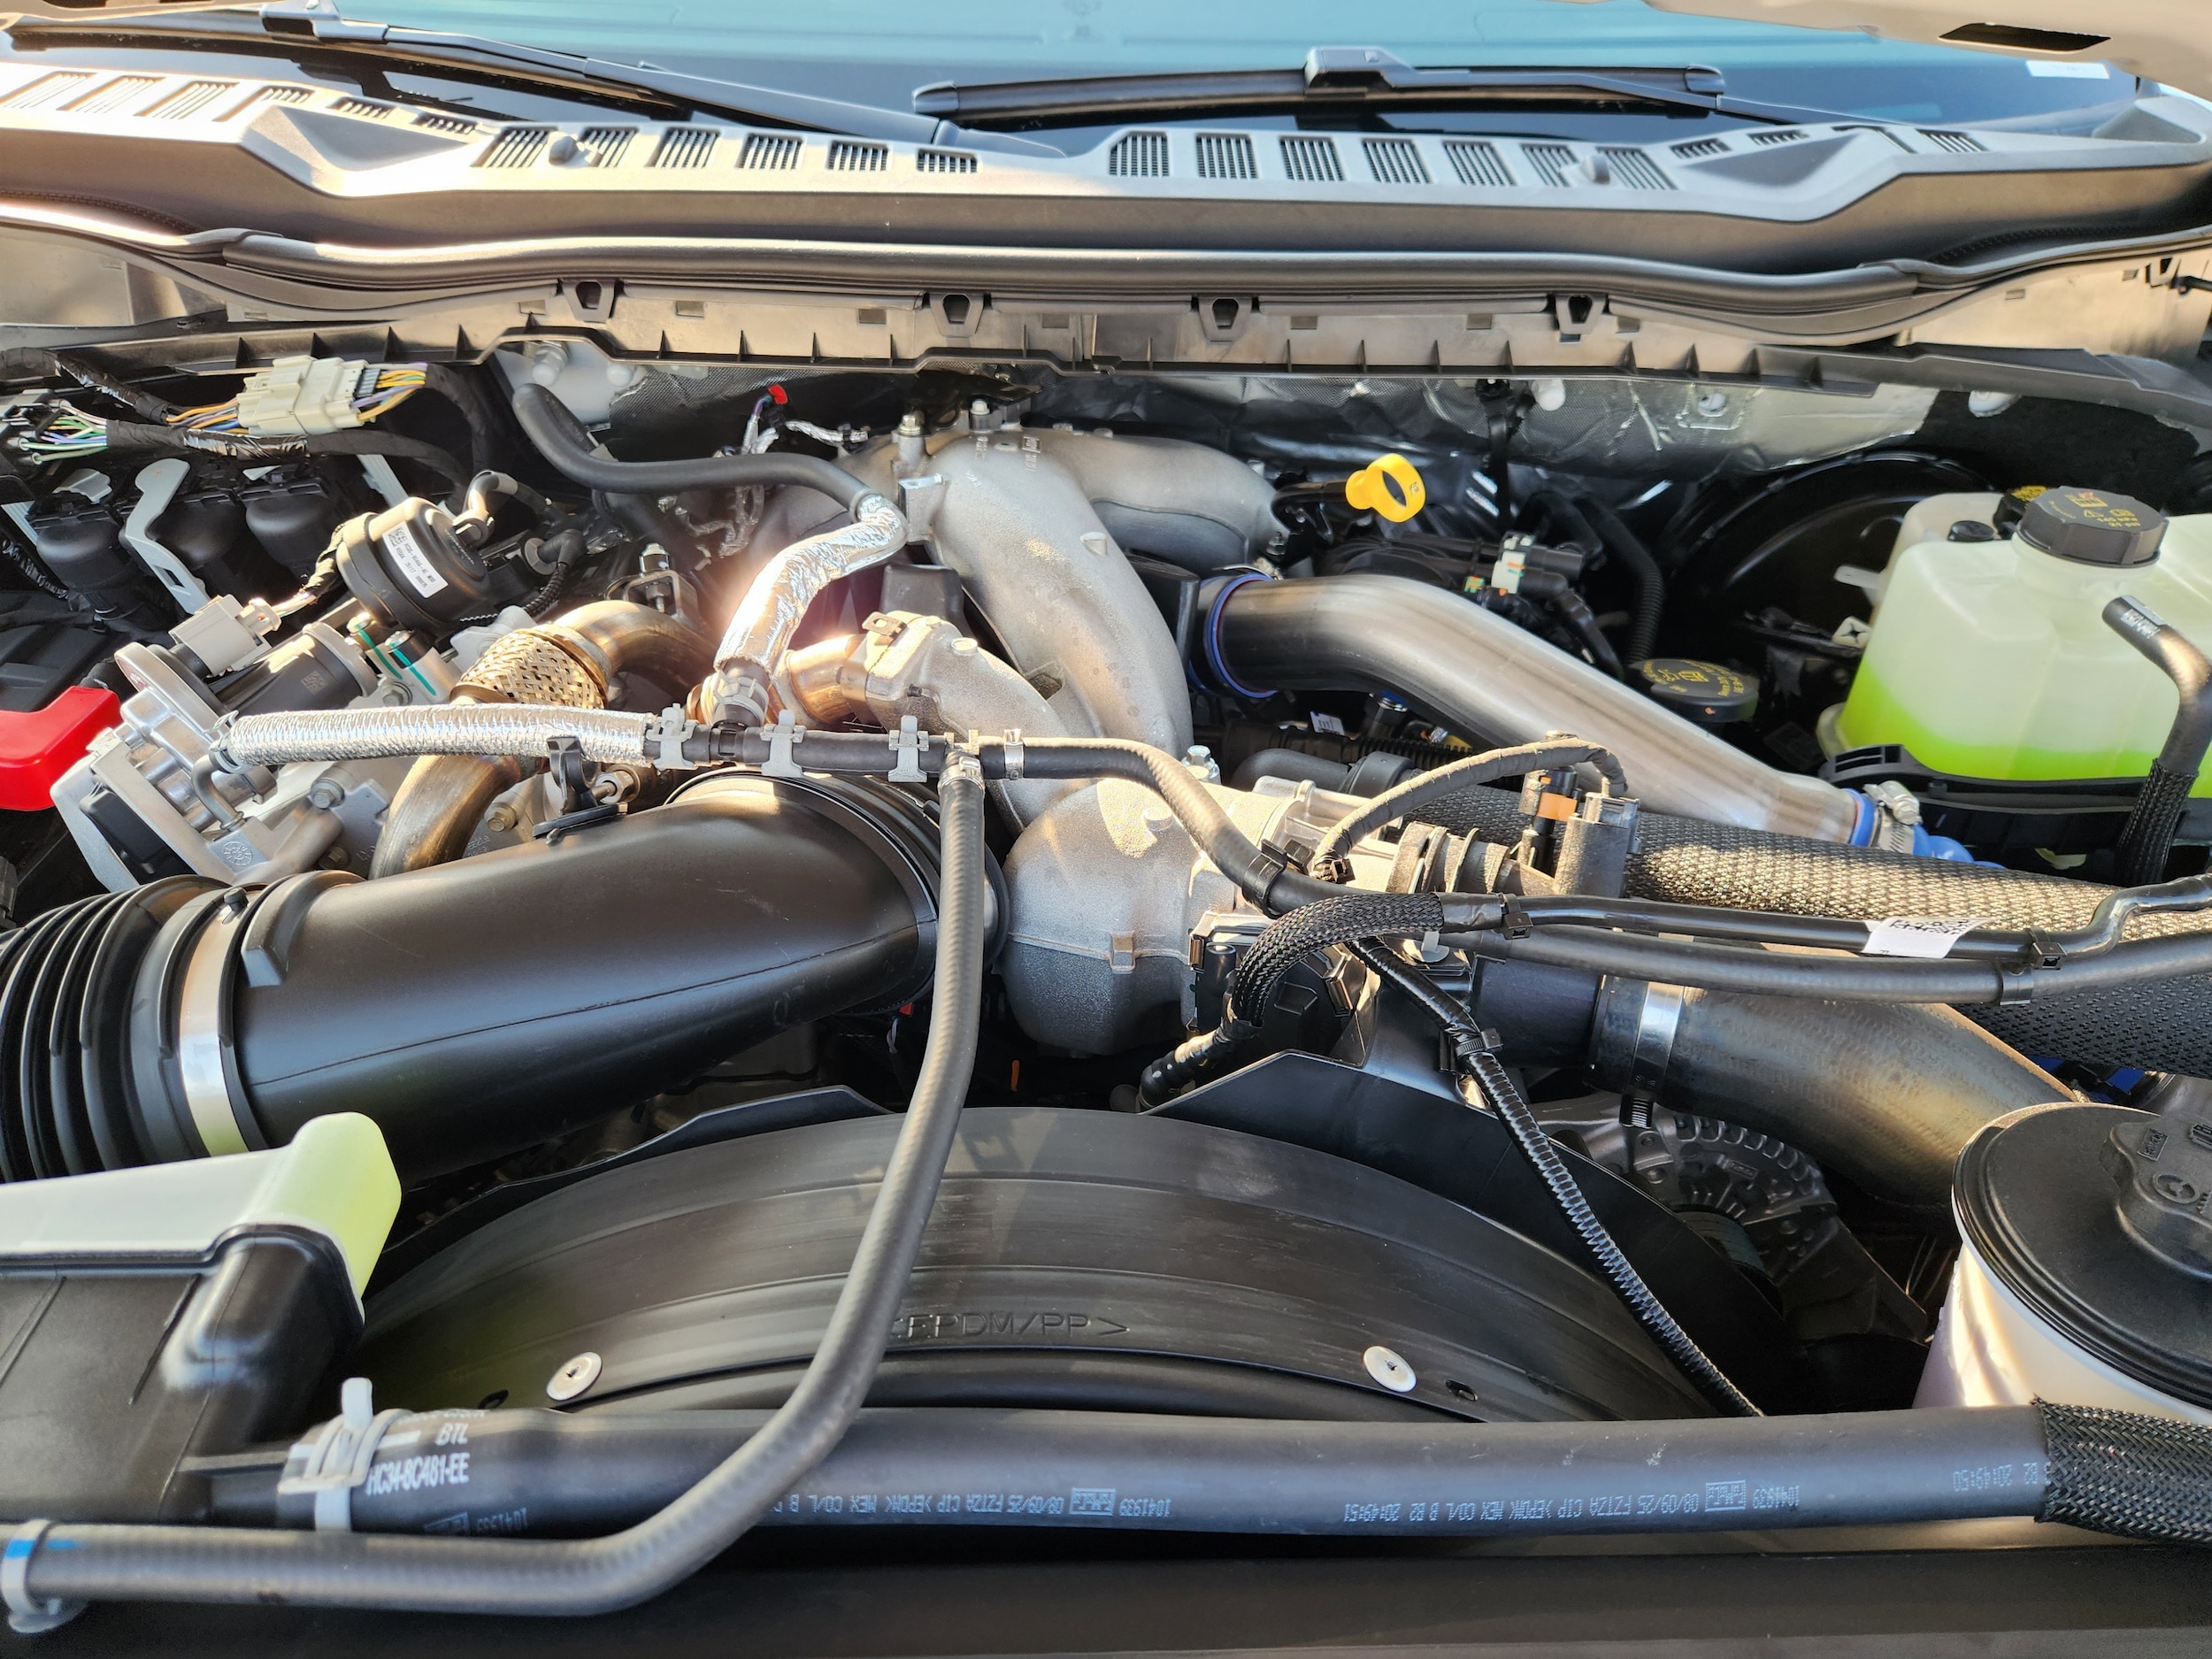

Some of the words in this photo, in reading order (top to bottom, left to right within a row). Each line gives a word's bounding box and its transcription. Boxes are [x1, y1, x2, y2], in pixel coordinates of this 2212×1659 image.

[435, 1423, 469, 1446] BTL
[849, 1494, 877, 1514] MEX
[1006, 1494, 1064, 1515] 08/09/25
[1637, 1493, 1700, 1515] 08/09/25
